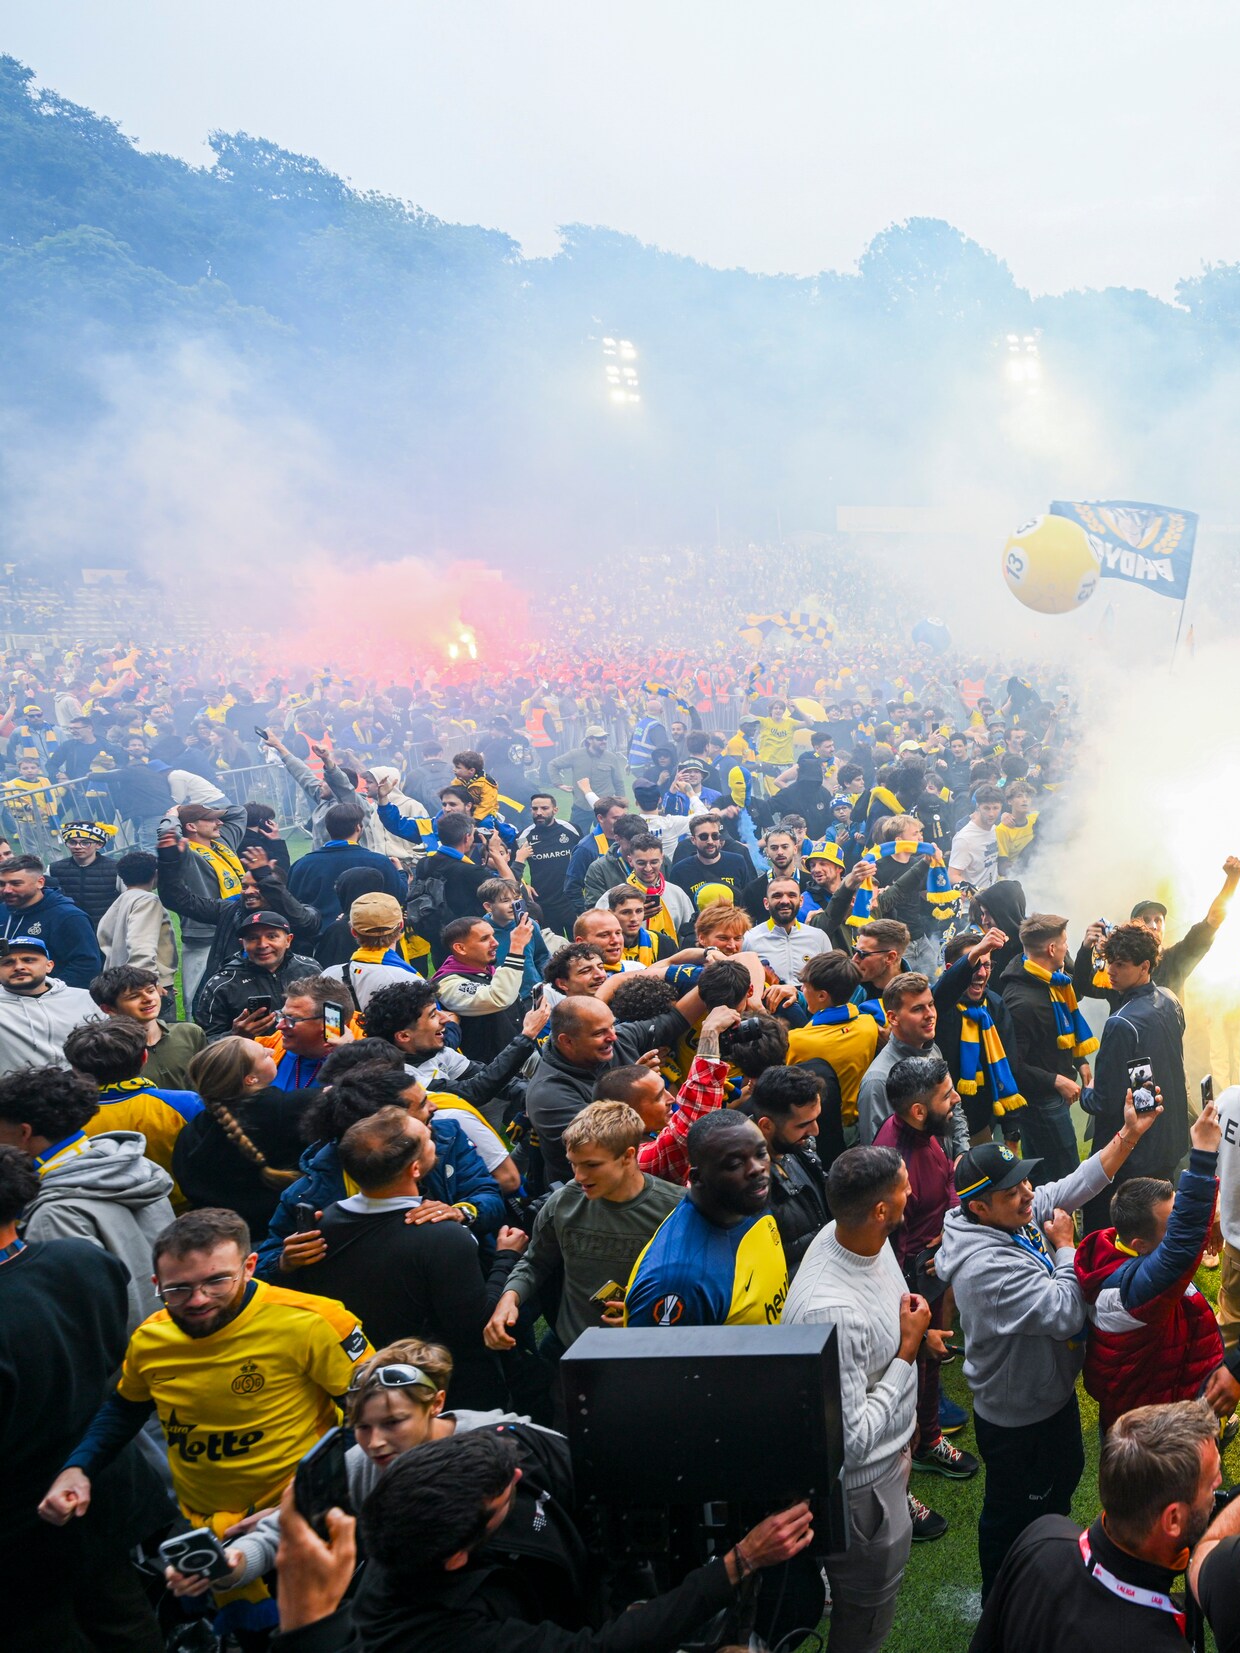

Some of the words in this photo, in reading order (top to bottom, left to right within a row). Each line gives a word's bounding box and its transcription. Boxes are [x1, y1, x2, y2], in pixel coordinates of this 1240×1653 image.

[1006, 553, 1024, 580] 13
[532, 849, 571, 860] COMARCH
[178, 1430, 264, 1463] Lotto
